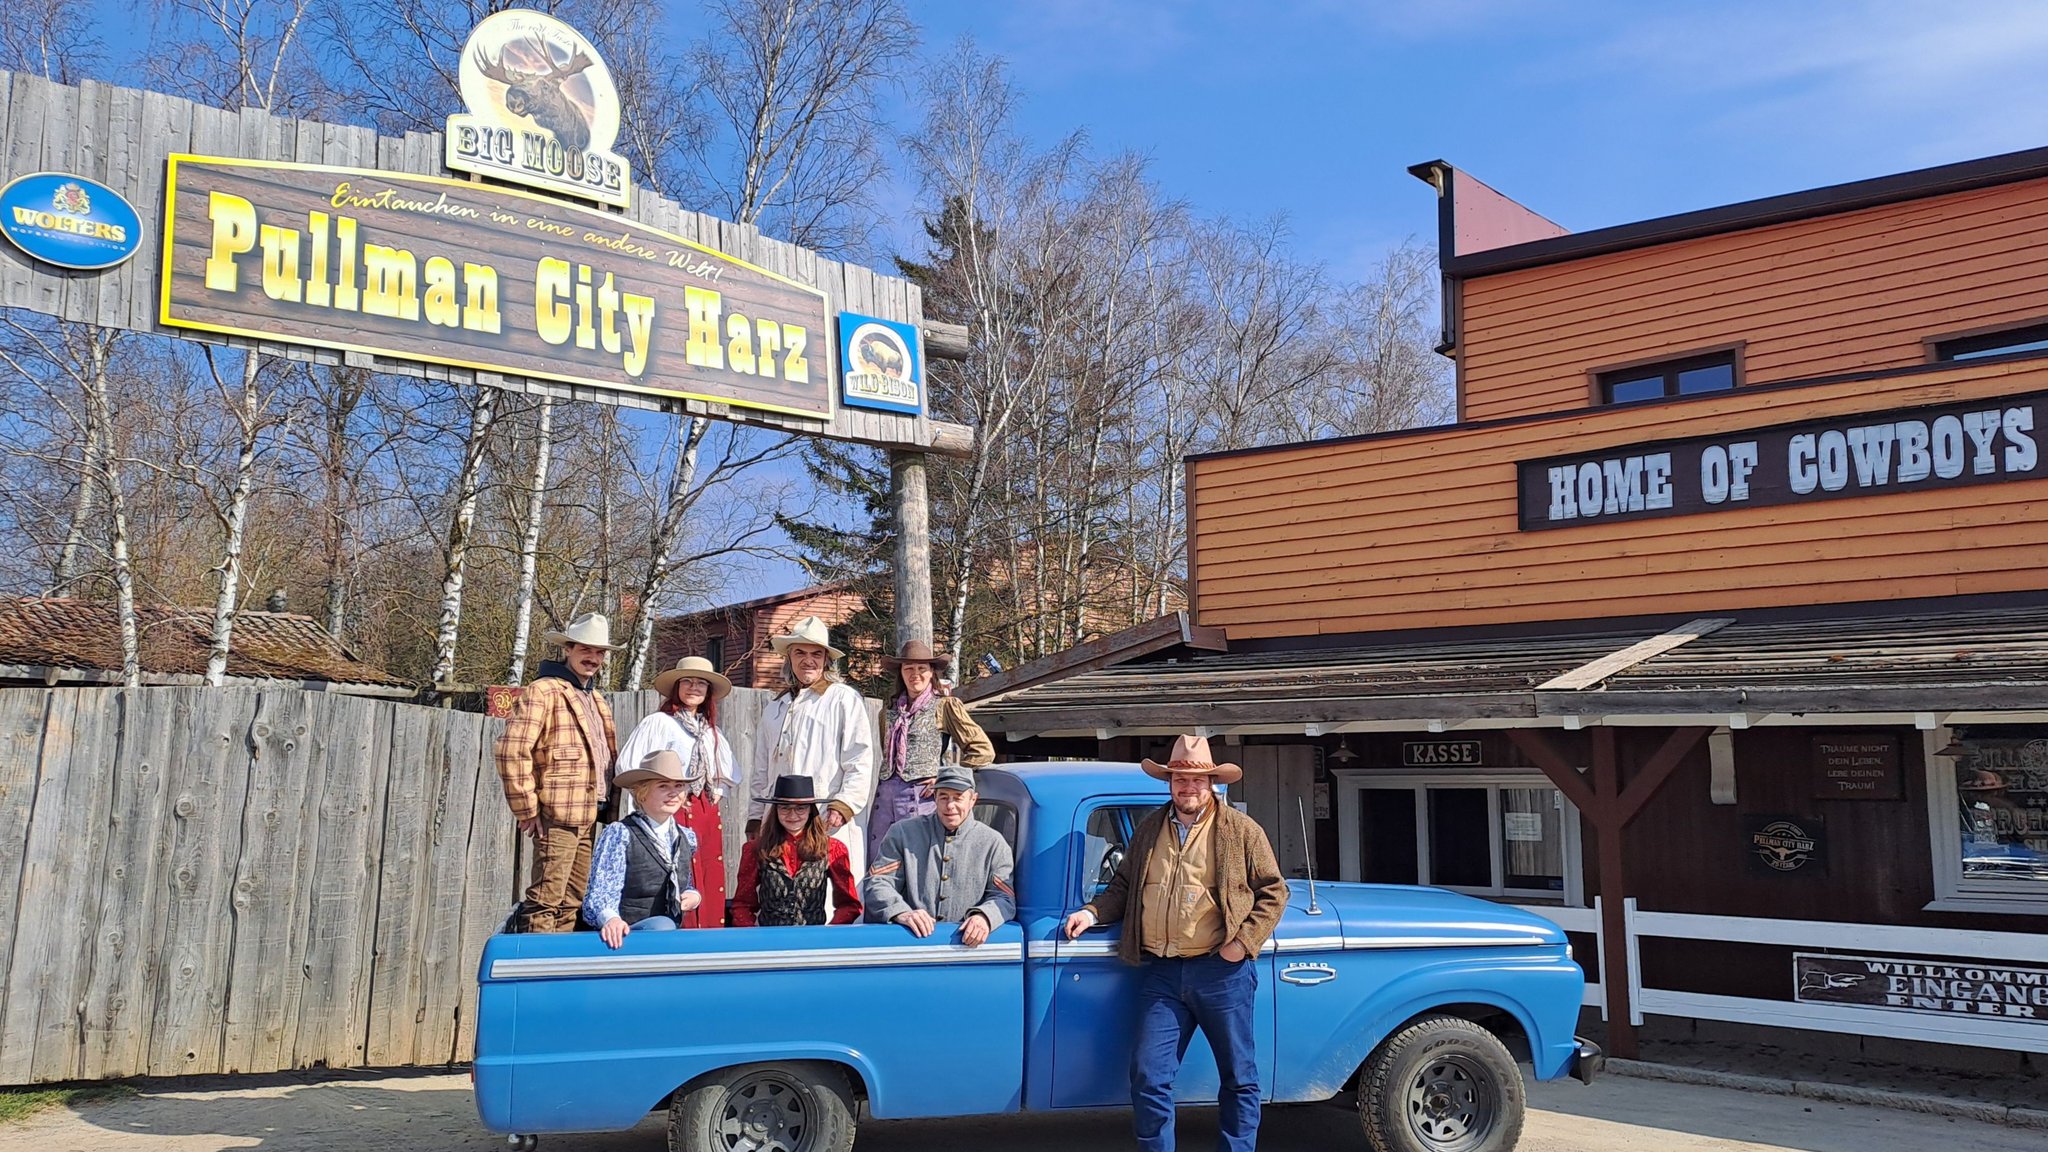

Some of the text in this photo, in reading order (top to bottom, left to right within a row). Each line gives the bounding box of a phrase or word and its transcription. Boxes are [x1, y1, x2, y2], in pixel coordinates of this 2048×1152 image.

[457, 125, 622, 191] BIG MOOSE
[12, 206, 126, 243] WOLTERS
[330, 182, 725, 283] Eintauchen in eine andere Welt!
[204, 190, 809, 384] Pullman City Harz
[849, 374, 915, 399] WILD BISON
[1548, 406, 2038, 520] HOME OF COWBOYS
[1413, 744, 1473, 763] KASSE
[1861, 744, 1889, 753] NICHT
[1864, 961, 2048, 986] WILLKOMM
[1886, 994, 2036, 1017] ENTER
